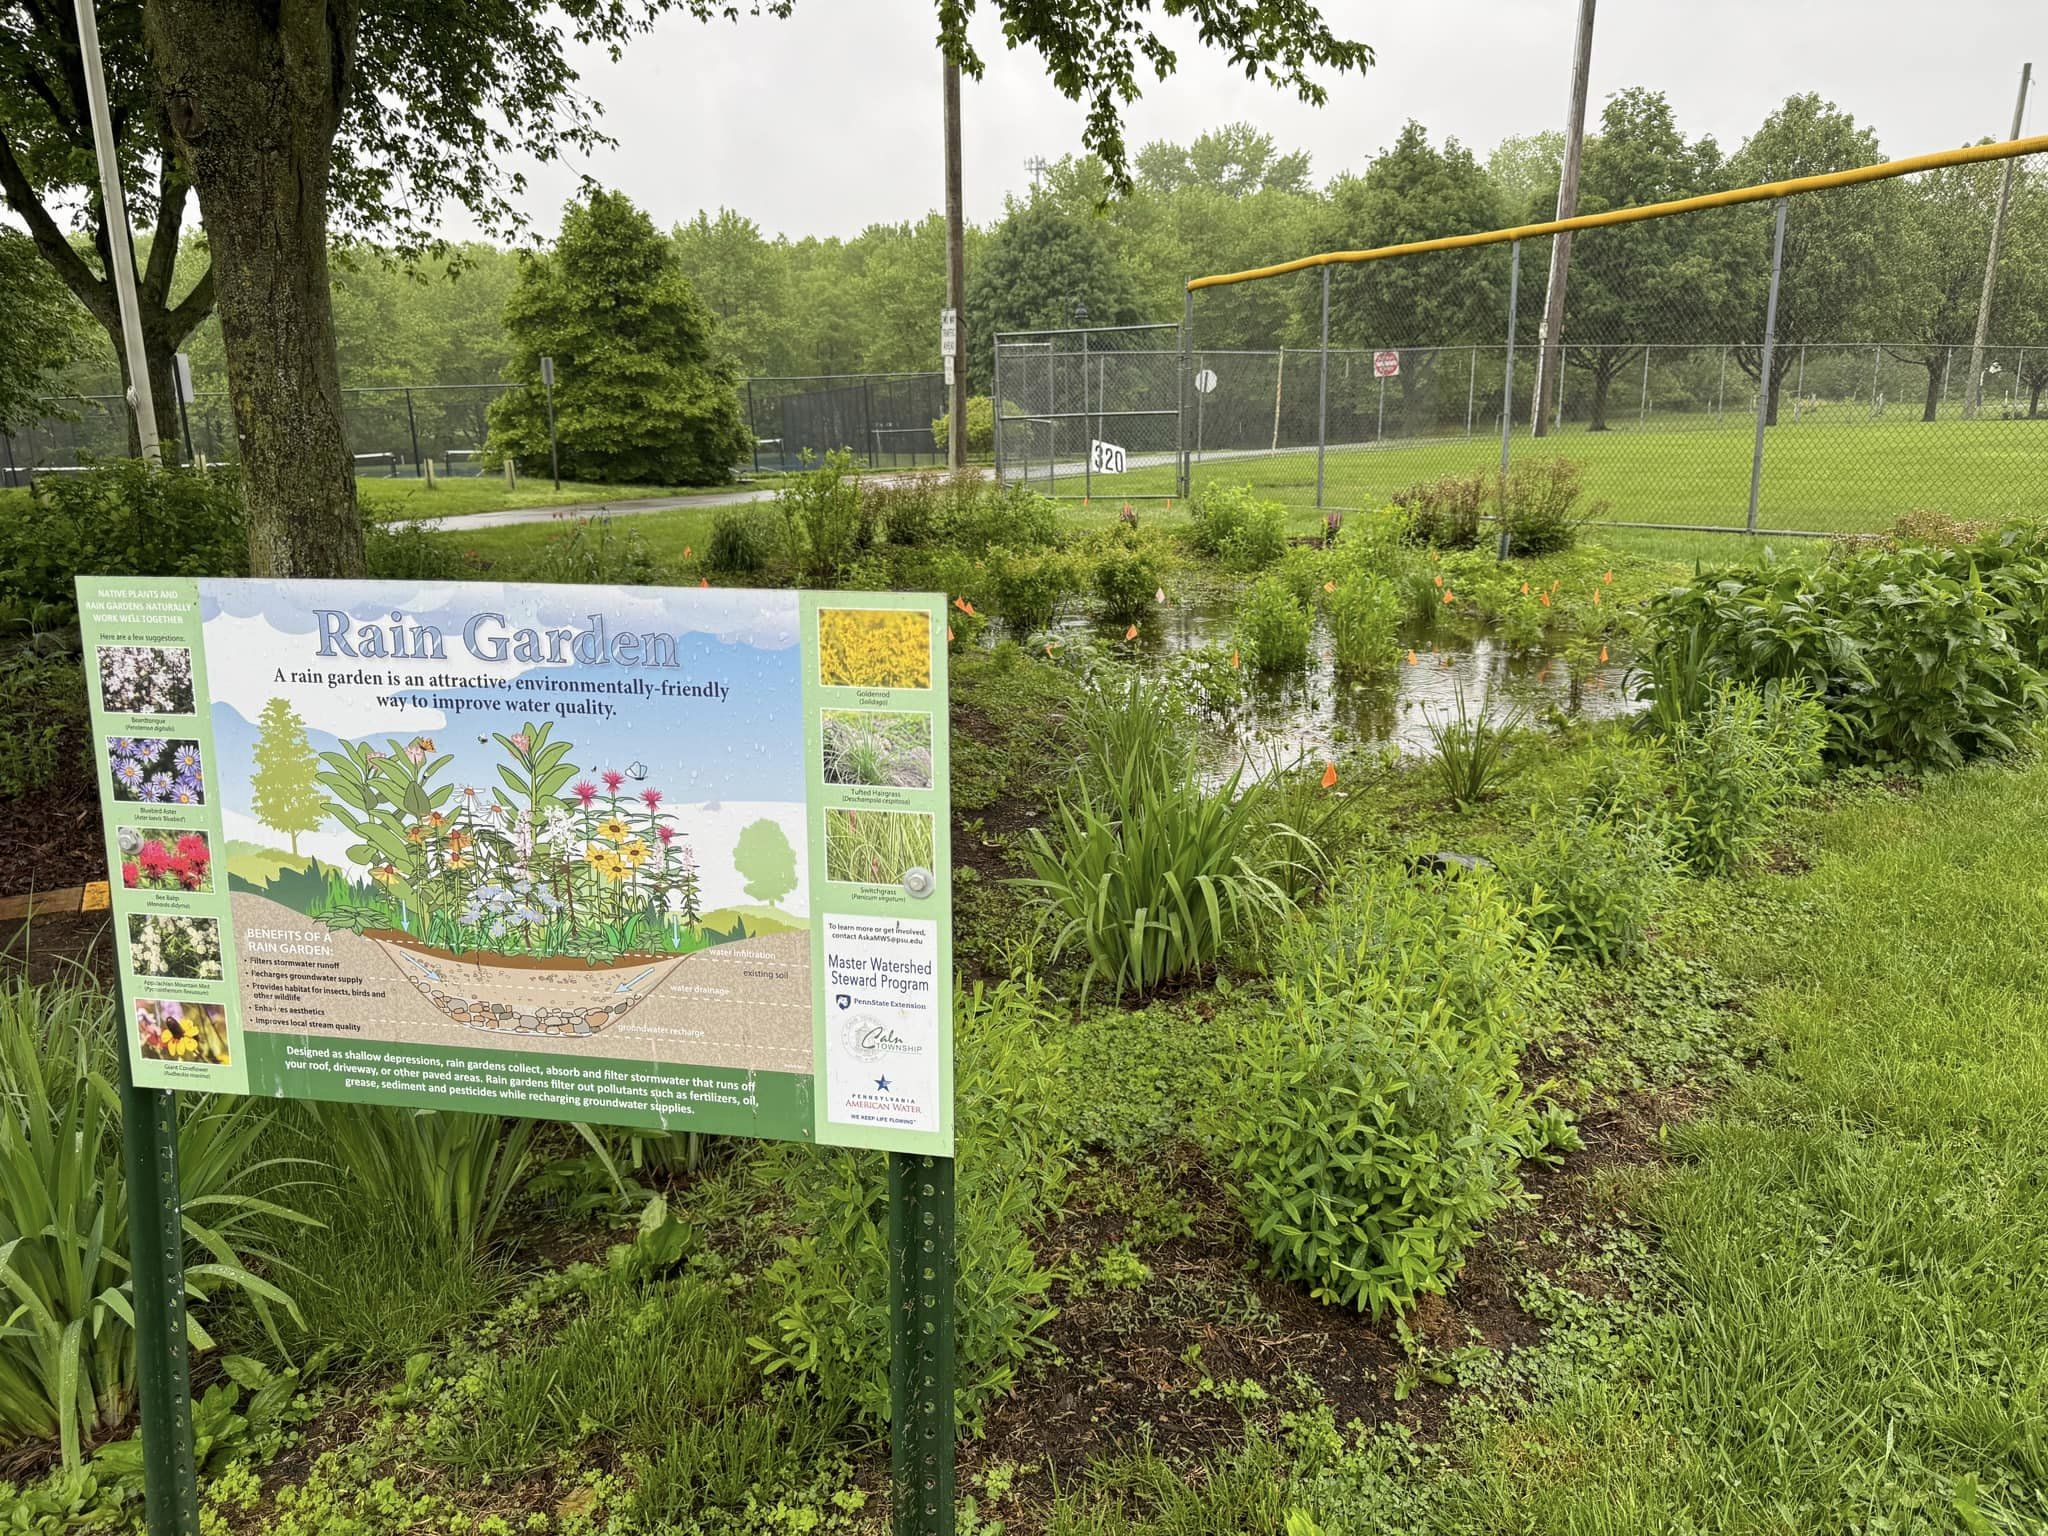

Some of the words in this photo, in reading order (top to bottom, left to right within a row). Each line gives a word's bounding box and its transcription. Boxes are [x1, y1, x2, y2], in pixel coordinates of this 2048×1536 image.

[1095, 445, 1123, 472] 320
[98, 590, 128, 598] NATIVE
[128, 590, 158, 598] PLANTS
[106, 602, 144, 611] GARDENS
[146, 603, 191, 611] NATURALLY
[93, 614, 119, 622] WORK
[120, 615, 140, 623] WELL
[141, 615, 183, 623] TOGETHER
[132, 633, 144, 641] few
[312, 609, 448, 660] Rain
[463, 613, 680, 667] Garden
[274, 667, 286, 683] A
[291, 668, 322, 684] rain
[327, 669, 383, 689] garden
[387, 671, 401, 686] is
[405, 675, 424, 687] an
[429, 673, 512, 692] attractive,
[516, 676, 729, 702] environmentally-friendly
[856, 690, 890, 698] Goldenrod
[376, 695, 407, 712] way
[412, 694, 428, 709] to
[432, 693, 501, 714] improve
[505, 699, 551, 713] water
[555, 699, 617, 720] quality.
[872, 789, 901, 798] Hairgrass
[860, 887, 896, 896] Switchgrass
[248, 928, 302, 941] BENEFITS
[304, 931, 320, 941] OF
[324, 934, 332, 942] A
[832, 932, 857, 940] contact
[896, 927, 926, 936] involved,
[248, 941, 277, 952] RAIN
[280, 943, 334, 956] GARDEN:
[709, 949, 733, 957] water
[734, 950, 776, 960] infiltration
[250, 957, 272, 965] Filters
[274, 959, 316, 968] stormwater
[828, 953, 867, 970] Master
[870, 957, 932, 975] Watershed
[290, 973, 336, 982] groundwater
[338, 976, 363, 984] supply
[743, 969, 773, 979] existing
[775, 971, 789, 979] soil
[252, 983, 284, 991] Provides
[831, 971, 877, 987] Steward
[881, 974, 929, 993] Program
[670, 984, 694, 993] water
[695, 985, 730, 995] drainage
[255, 1004, 288, 1013] Enhaes
[290, 1007, 325, 1015] aesthetics
[891, 1001, 926, 1009] Extension
[256, 1017, 289, 1026] Improves
[290, 1019, 308, 1027] local
[309, 1021, 334, 1029] stream
[336, 1023, 360, 1032] quality
[670, 1027, 705, 1038] recharge
[862, 1026, 903, 1048] Caln
[877, 1043, 922, 1052] TOWNSHIP
[286, 1046, 330, 1058] Designed
[332, 1052, 343, 1060] as
[345, 1050, 382, 1062] shallow
[383, 1053, 444, 1068] depressions,
[446, 1059, 465, 1067] rain
[467, 1059, 506, 1072] gardens
[508, 1062, 544, 1075] collect,
[546, 1065, 580, 1077] absorb
[583, 1069, 601, 1079] and
[604, 1069, 628, 1081] filter
[631, 1072, 690, 1087] stormwater
[692, 1077, 714, 1088] that
[716, 1081, 739, 1090] runs
[741, 1080, 756, 1091] off
[285, 1059, 307, 1070] your
[309, 1060, 332, 1072] roof,
[333, 1062, 379, 1076] driveway,
[381, 1068, 391, 1076] or
[394, 1067, 420, 1078] other
[423, 1071, 451, 1083] paved
[454, 1073, 483, 1083] areas.
[485, 1074, 508, 1085] Rain
[510, 1077, 549, 1090] gardens
[551, 1078, 574, 1090] filter
[577, 1083, 594, 1092] out
[597, 1083, 648, 1098] pollutants
[650, 1088, 674, 1099] such
[676, 1092, 688, 1100] as
[690, 1092, 740, 1106] fertilizers,
[743, 1096, 759, 1107] oil,
[345, 1077, 380, 1090] grease,
[381, 1080, 425, 1092] sediment
[428, 1083, 446, 1093] and
[449, 1083, 497, 1099] pesticides
[499, 1088, 527, 1100] while
[529, 1093, 581, 1107] recharging
[583, 1096, 648, 1110] groundwater
[650, 1102, 695, 1115] supplies.
[852, 1094, 915, 1104] PENNSYLVANIA
[846, 1099, 890, 1110] AMERICAN
